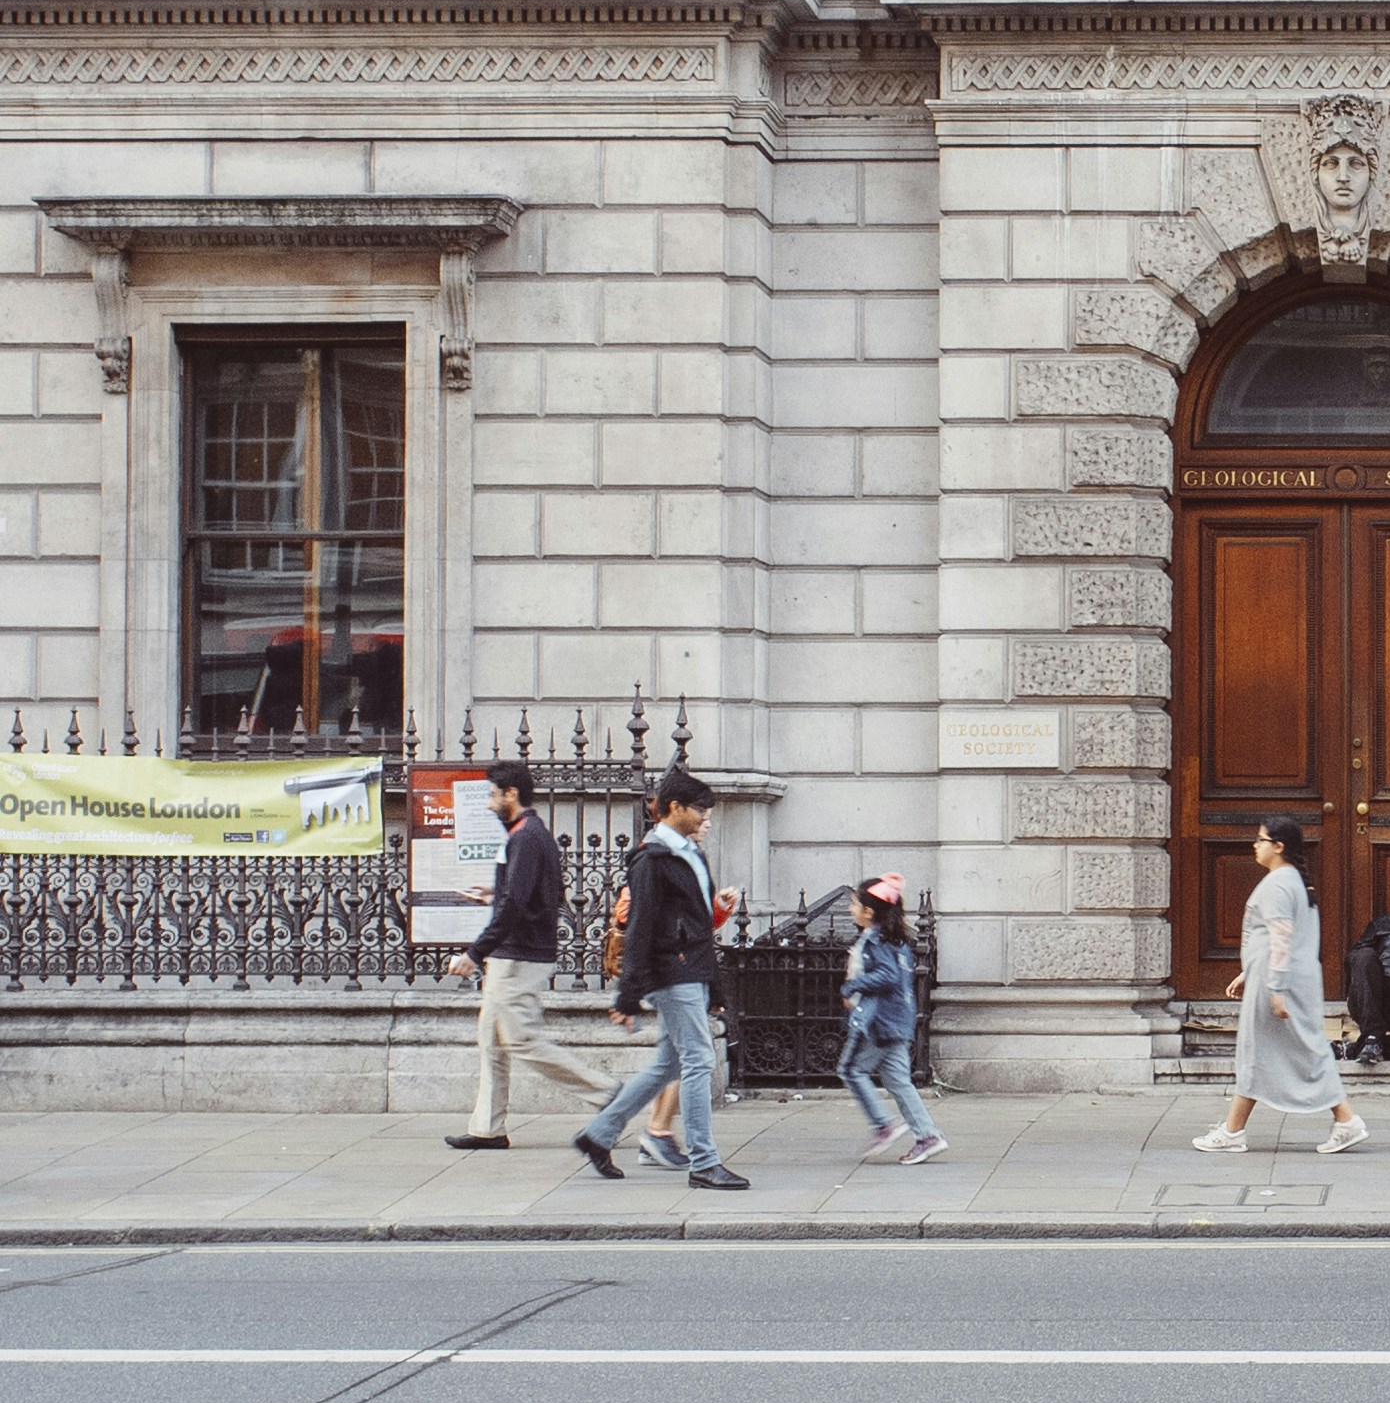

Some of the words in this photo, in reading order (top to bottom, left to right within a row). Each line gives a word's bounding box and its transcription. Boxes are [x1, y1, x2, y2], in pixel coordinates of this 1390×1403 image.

[1183, 469, 1322, 487] GEOLOGICAL
[945, 724, 1054, 737] GEOLOGICAL
[963, 742, 1036, 755] SOCIETY
[0, 793, 66, 822] Open
[70, 795, 146, 818] House
[150, 797, 241, 819] London
